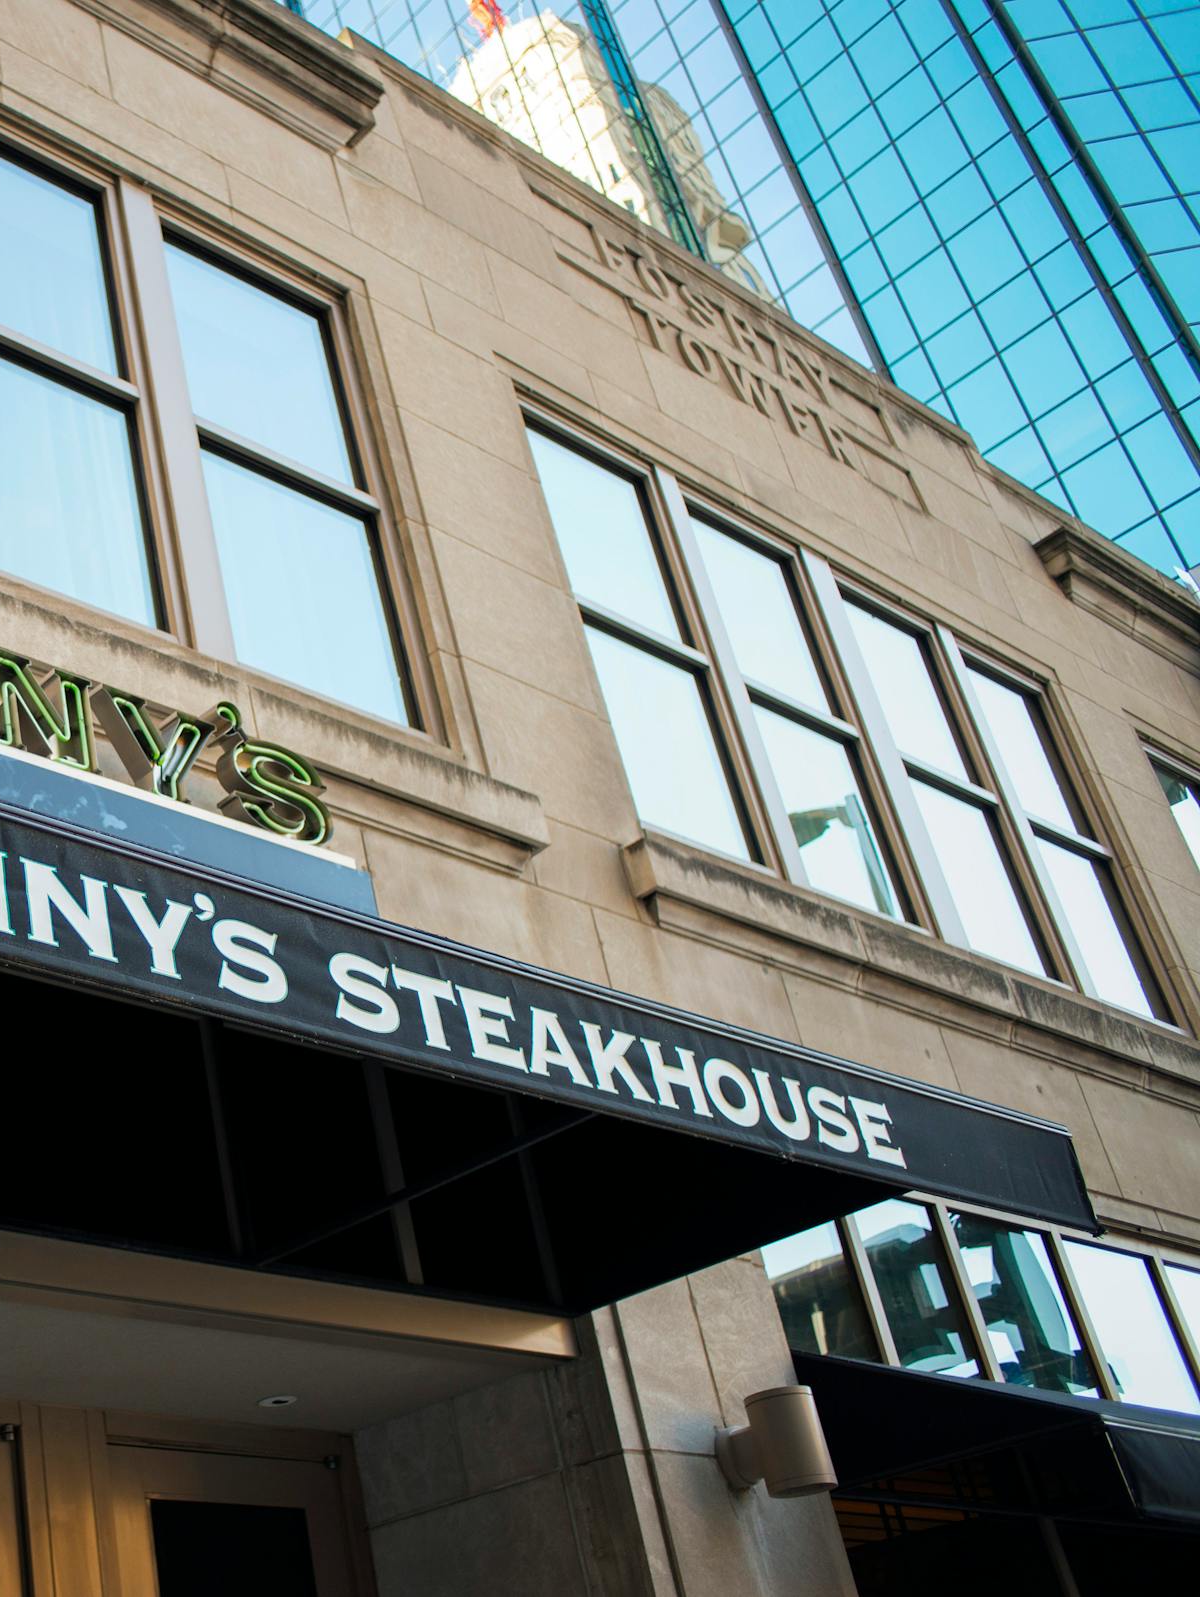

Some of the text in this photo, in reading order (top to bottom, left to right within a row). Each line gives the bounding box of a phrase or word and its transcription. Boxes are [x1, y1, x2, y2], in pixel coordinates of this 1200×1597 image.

[588, 221, 834, 409] FOSHAY
[625, 294, 862, 474] TOWER
[329, 953, 907, 1170] STEAKHOUSE
